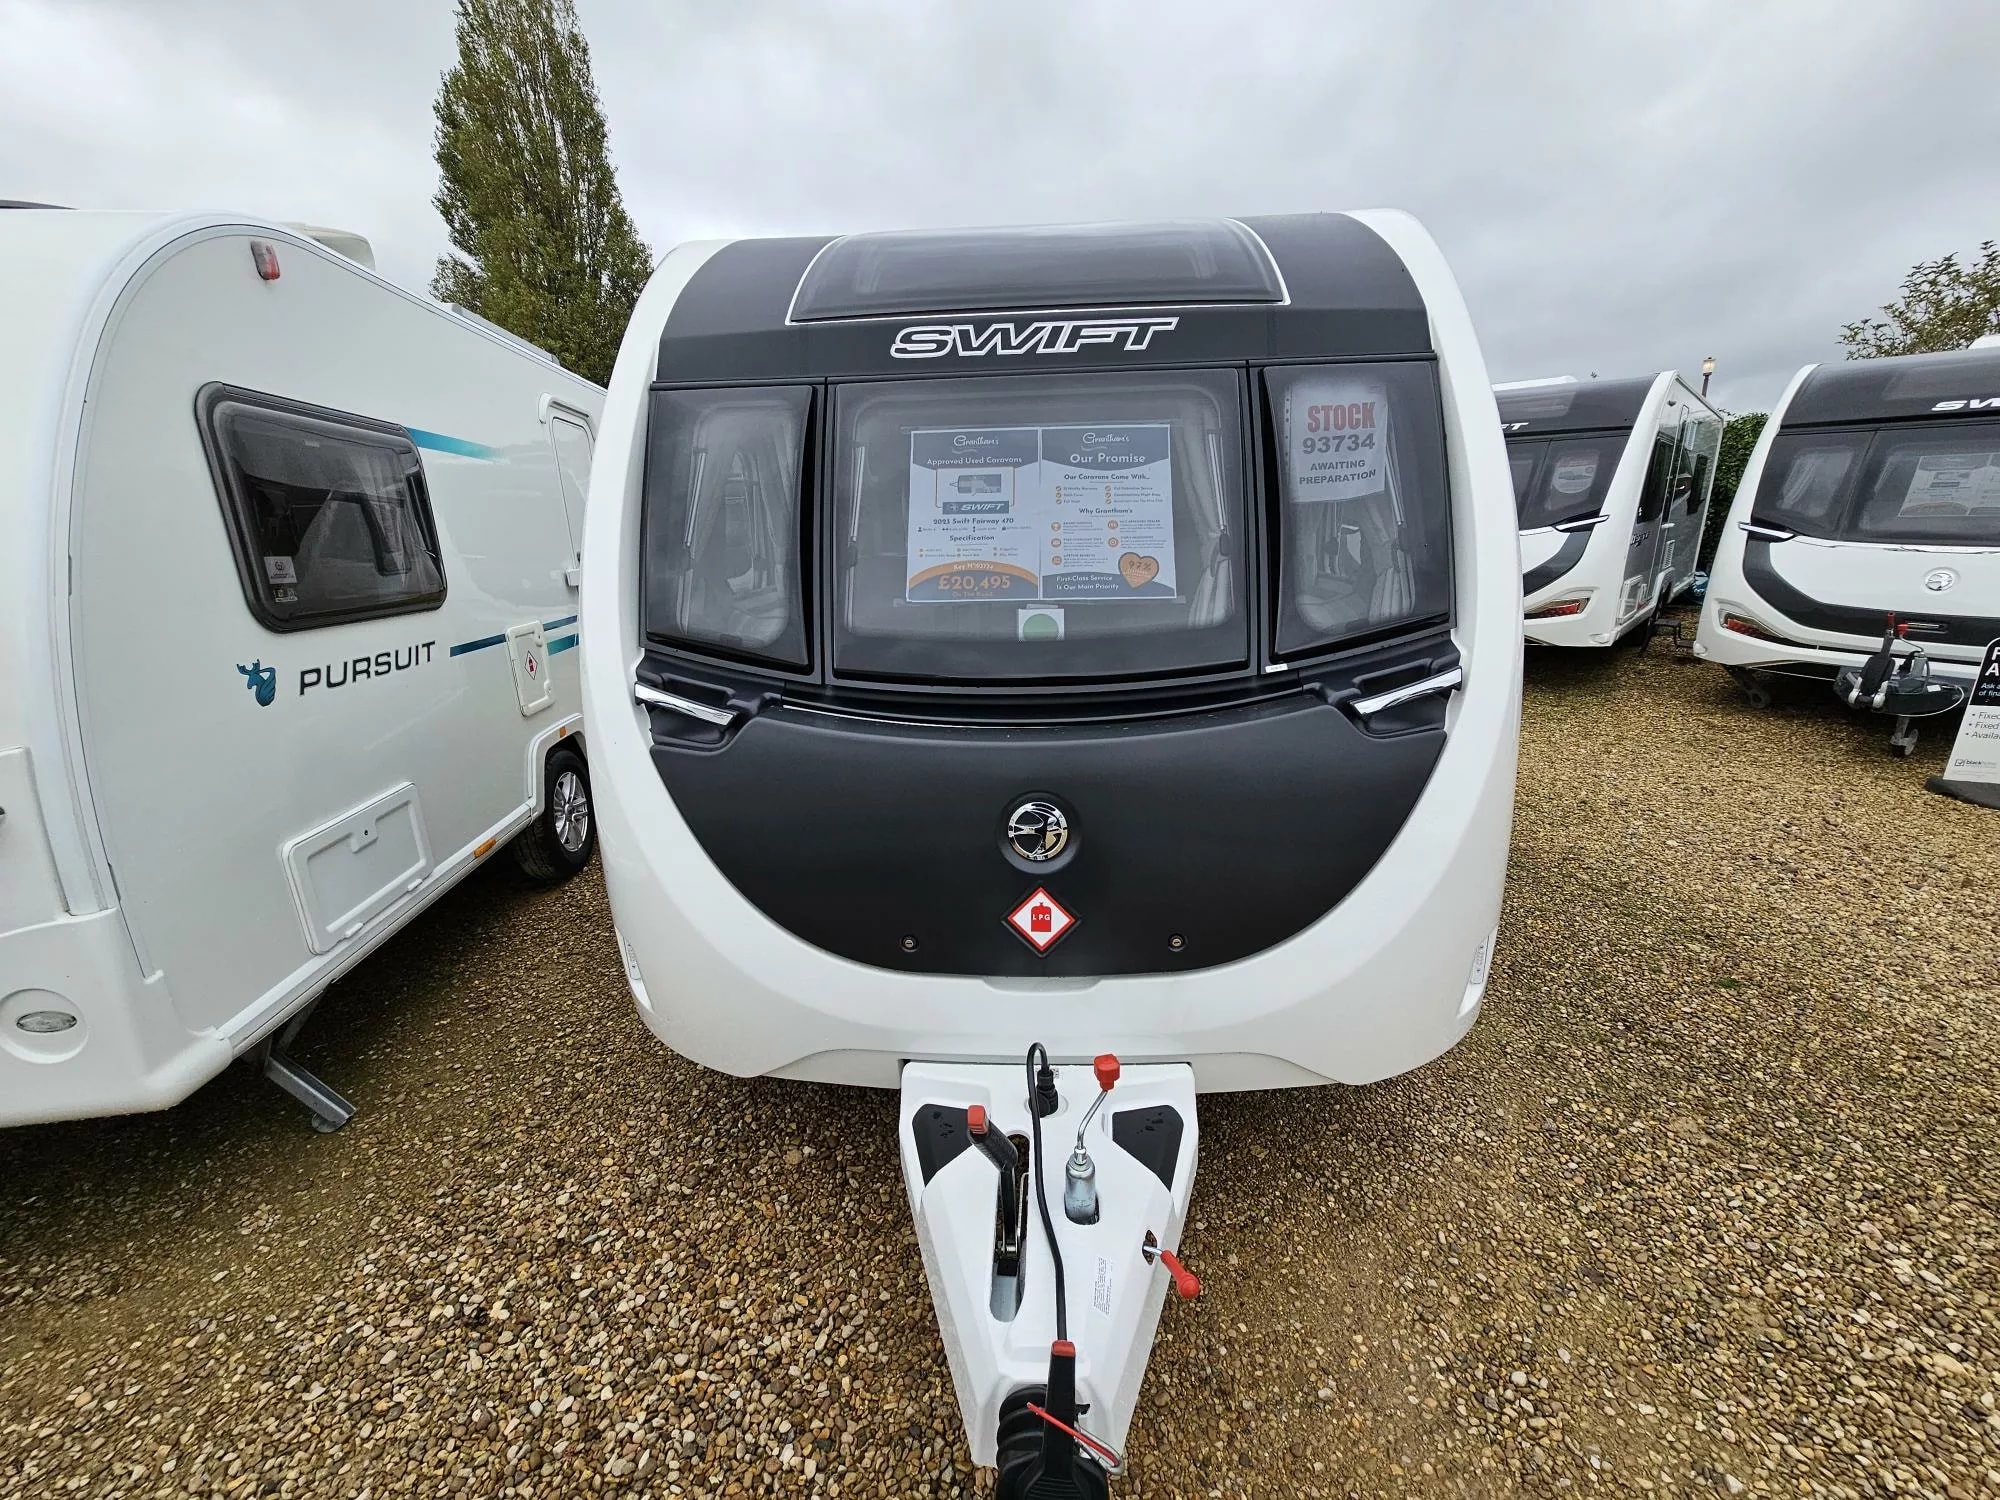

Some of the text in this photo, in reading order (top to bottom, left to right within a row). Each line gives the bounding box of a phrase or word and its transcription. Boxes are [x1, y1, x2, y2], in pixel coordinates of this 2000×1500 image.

[890, 316, 1180, 359] SWIFT
[1307, 401, 1377, 433] STOCK
[1302, 433, 1376, 455] 93734
[927, 458, 964, 466] Approved
[986, 456, 1023, 464] Caravans
[1070, 452, 1146, 463] Our Promise
[1310, 459, 1366, 472] AWAITING
[1299, 469, 1377, 485] PREPARATION
[960, 503, 1005, 511] SWIFT
[1079, 507, 1094, 515] Why
[952, 517, 970, 525] Swift
[972, 517, 1000, 525] Fairway
[949, 534, 995, 542] Specification
[938, 575, 1011, 592] £20,495
[1095, 583, 1119, 591] Priority
[299, 640, 436, 696] PURSUIT
[1032, 913, 1051, 921] LPG
